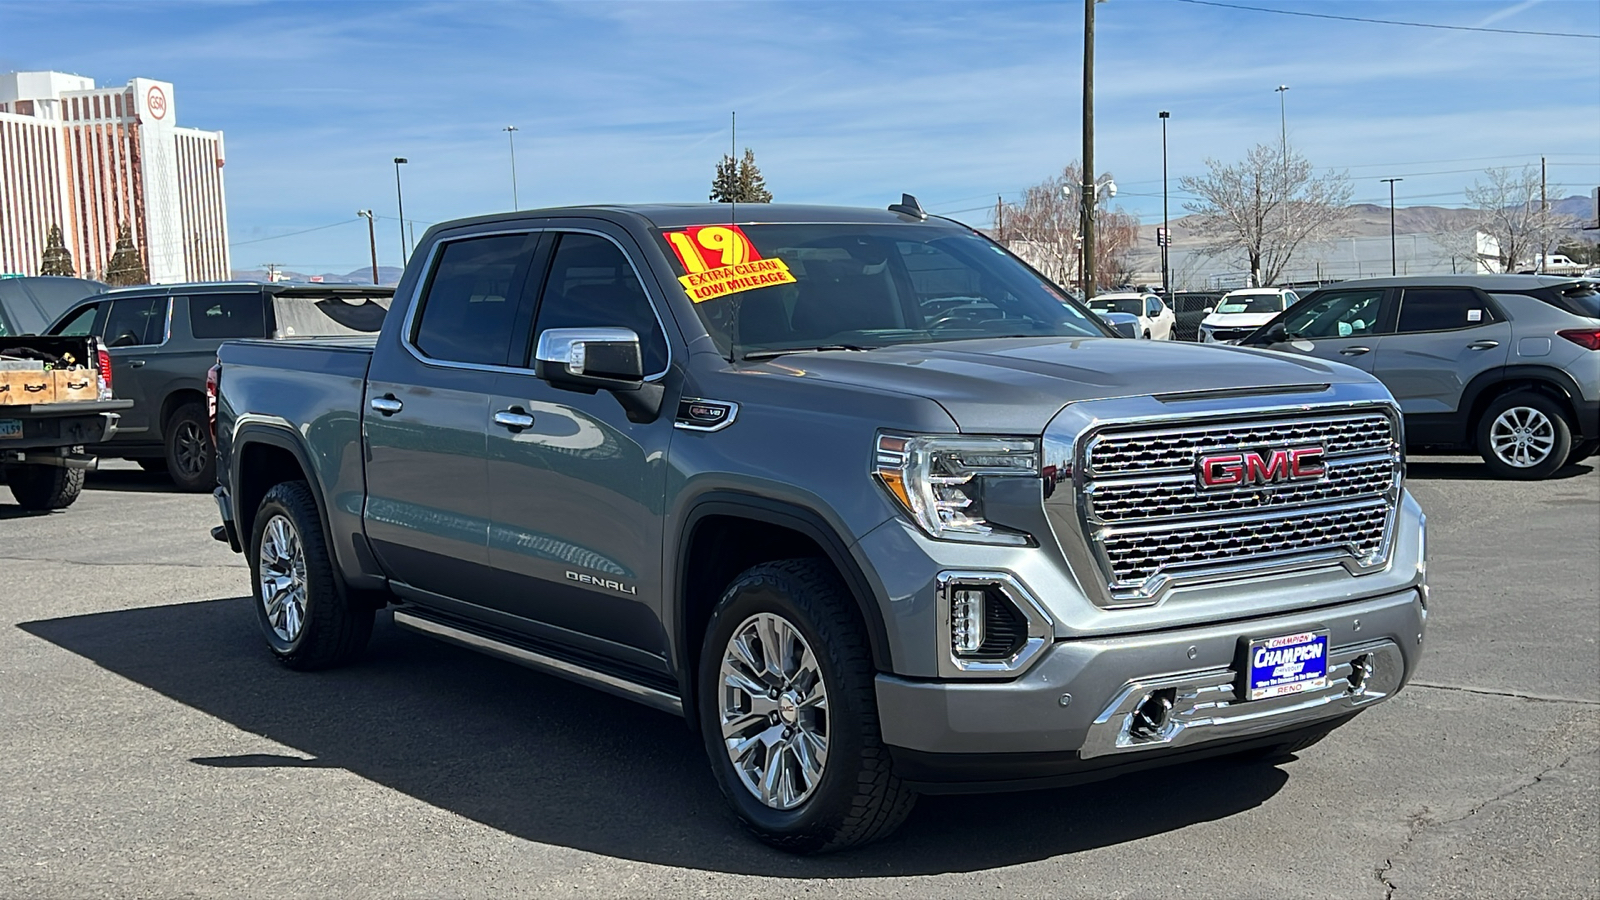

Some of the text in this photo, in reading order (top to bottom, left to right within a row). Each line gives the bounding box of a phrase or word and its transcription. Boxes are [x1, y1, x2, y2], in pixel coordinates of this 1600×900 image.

[150, 95, 164, 110] GSR
[670, 226, 749, 274] 19
[688, 260, 778, 286] EXTRA CLEAN
[693, 271, 787, 299] LOW MILEAGE
[1201, 446, 1324, 488] GMC
[565, 570, 637, 595] DENALI
[1272, 635, 1309, 647] CHAMPION
[1254, 643, 1323, 668] CHAMPION
[1277, 684, 1302, 694] RENO
